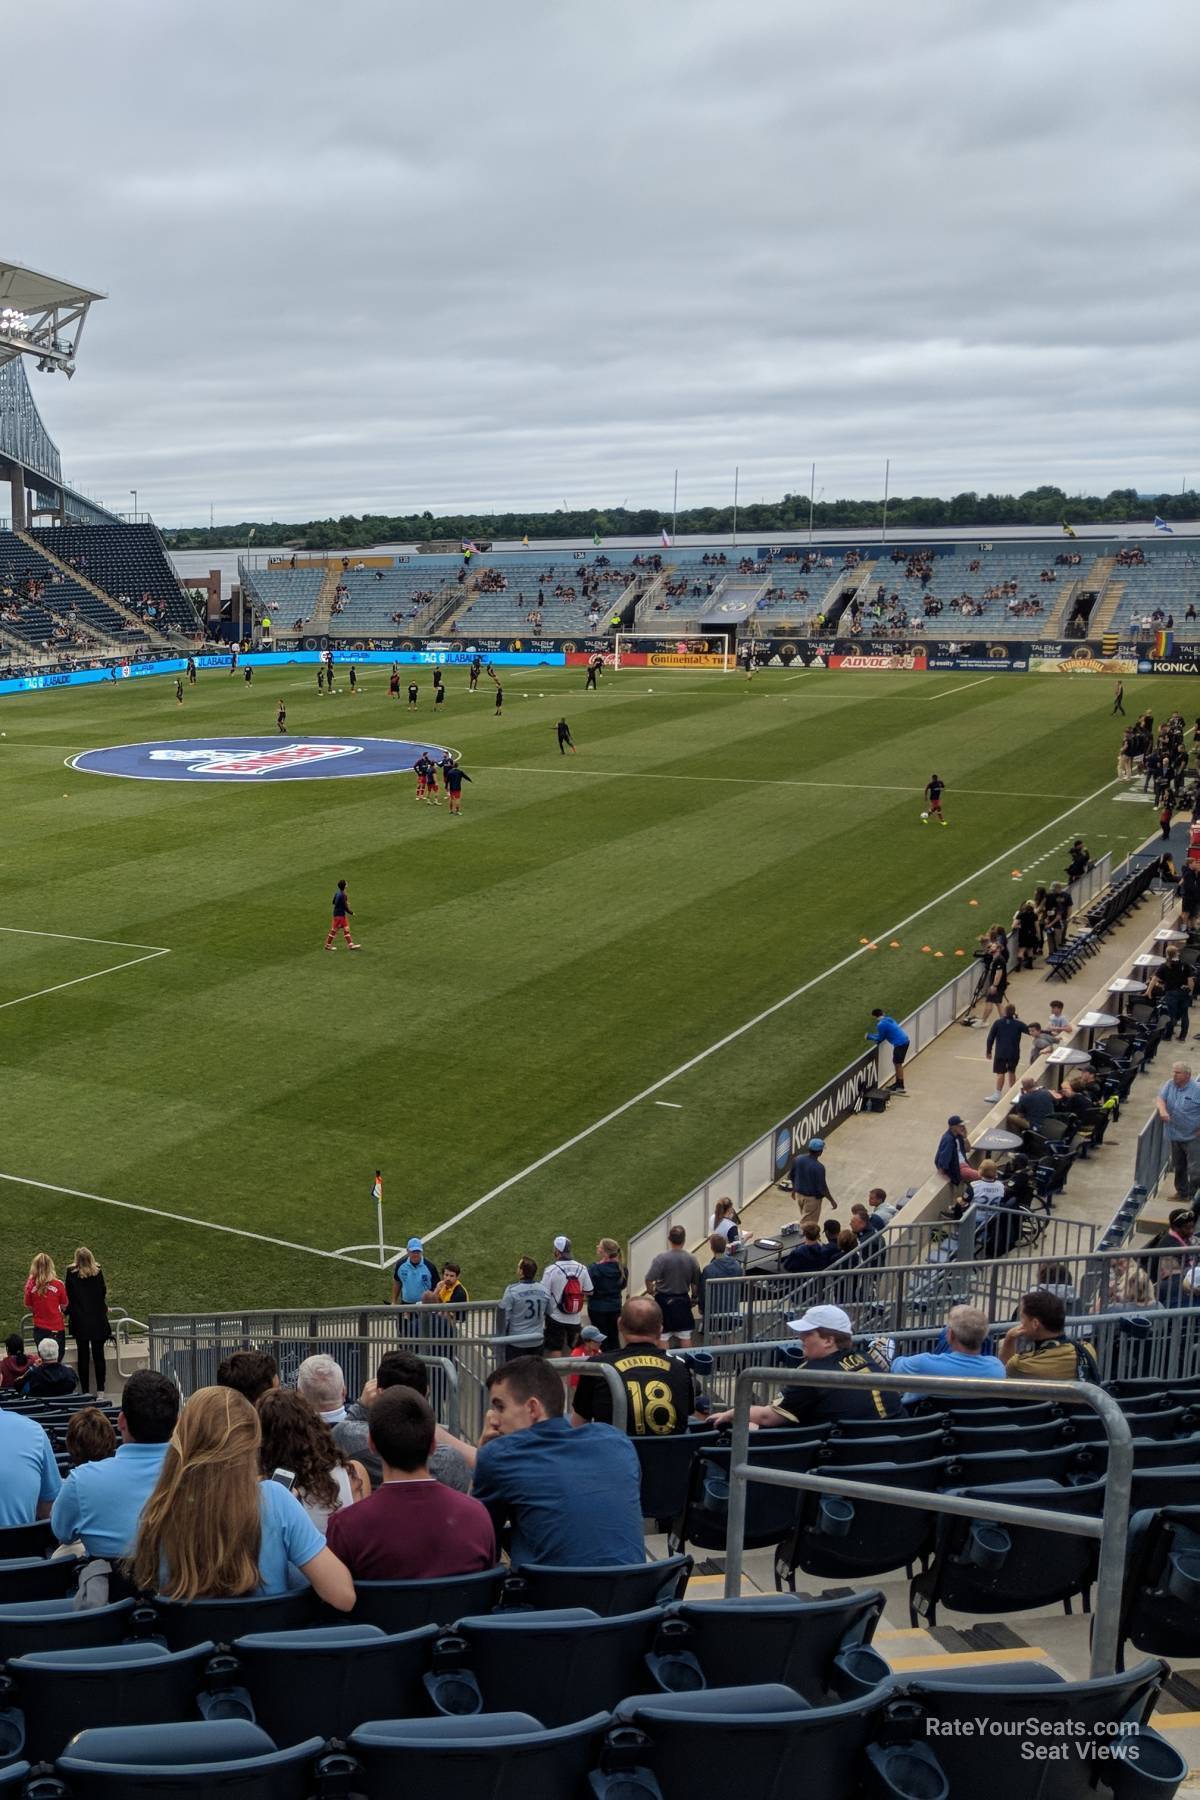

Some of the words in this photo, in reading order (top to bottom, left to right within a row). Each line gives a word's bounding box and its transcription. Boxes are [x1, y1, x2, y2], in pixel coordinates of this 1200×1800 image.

[420, 653, 437, 663] TAG
[650, 655, 702, 665] Continental
[1153, 662, 1198, 672] KONICA
[792, 1098, 835, 1155] KONICA
[835, 1059, 878, 1116] MINOLTA
[524, 1299, 541, 1320] 31
[622, 1356, 665, 1368] FEARLESS
[627, 1380, 677, 1436] 18
